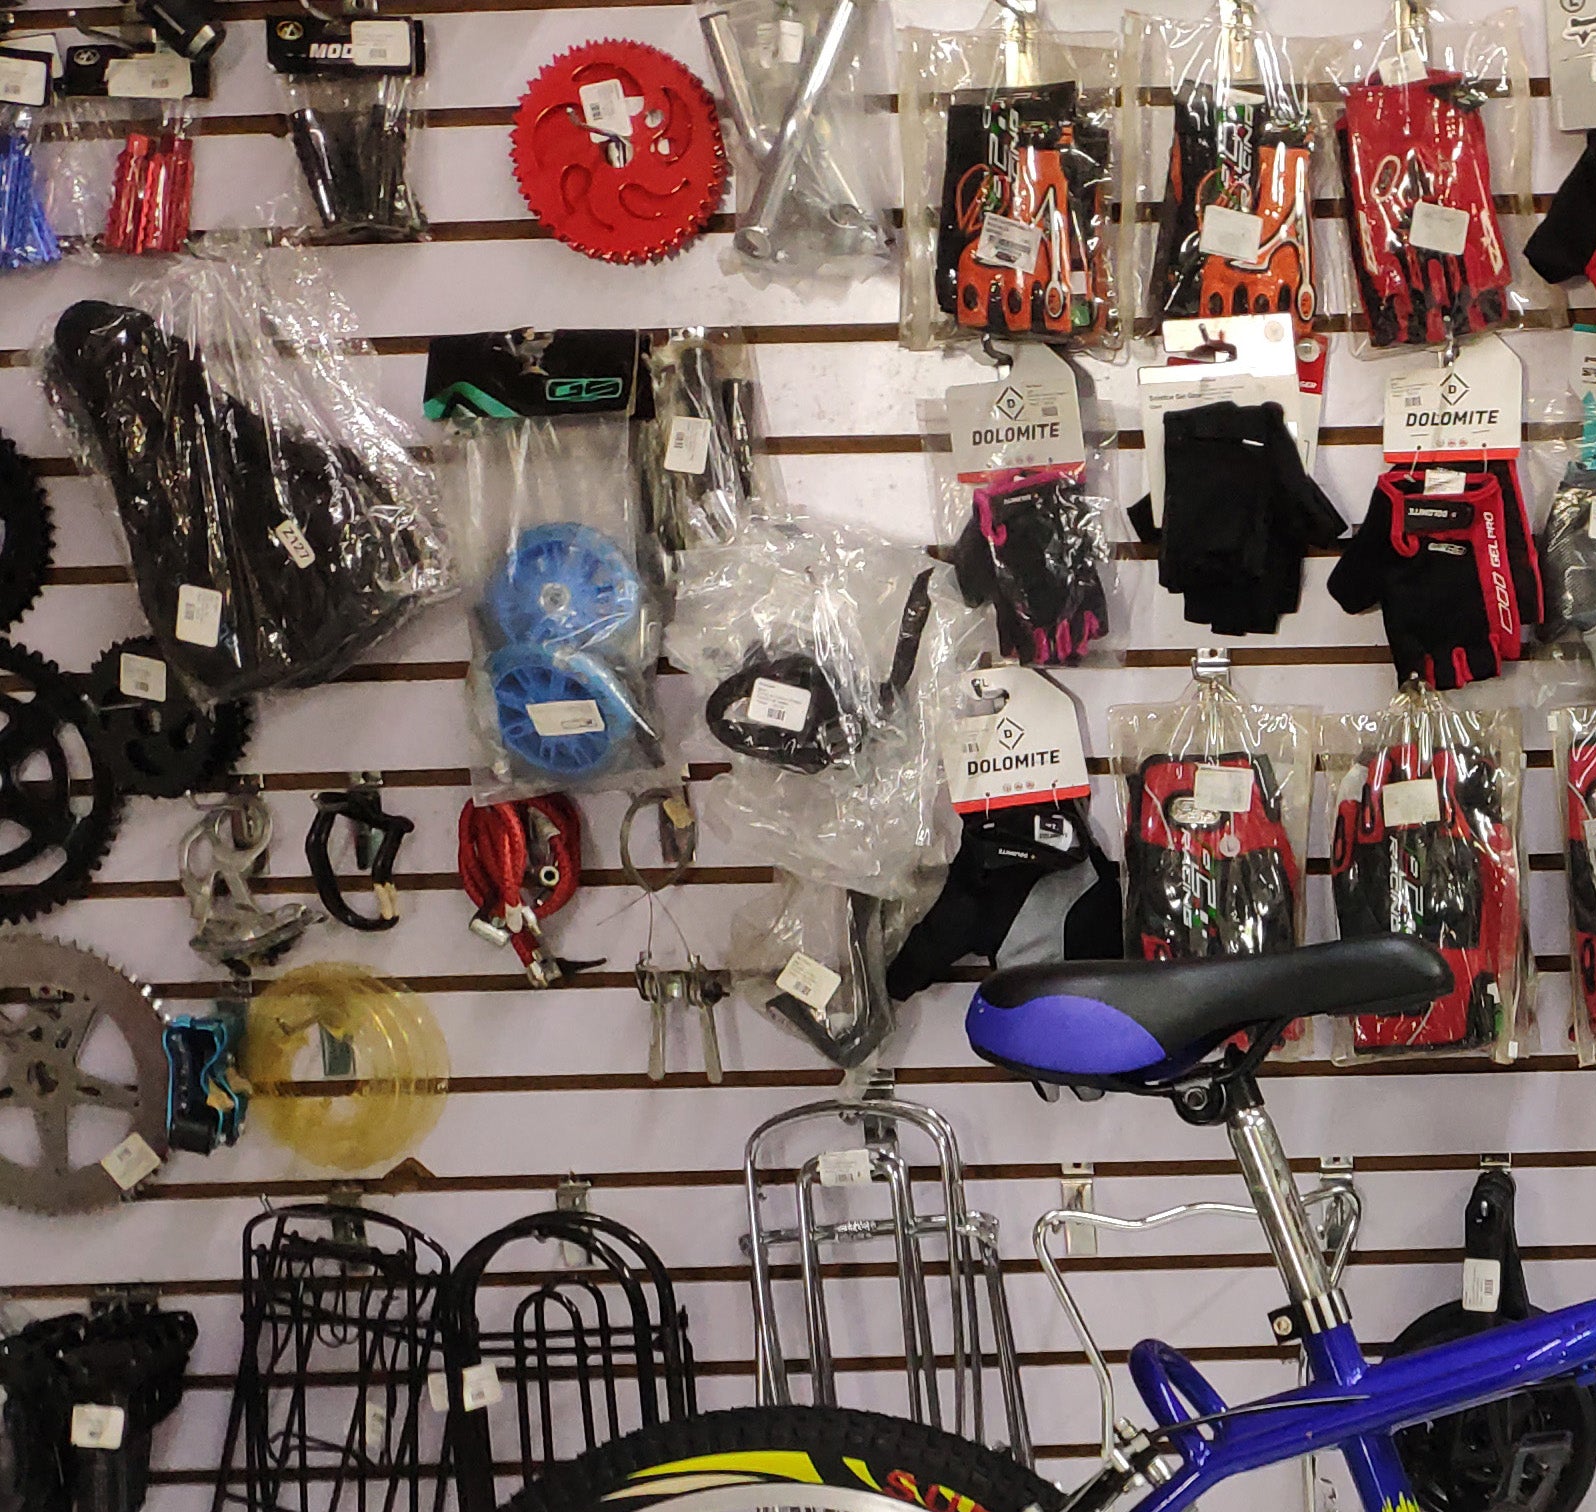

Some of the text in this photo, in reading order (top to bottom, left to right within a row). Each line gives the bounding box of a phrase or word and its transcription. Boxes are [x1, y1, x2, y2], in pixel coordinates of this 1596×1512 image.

[972, 422, 1061, 446] DOLOMITE
[1406, 410, 1499, 427] DOLOMITE
[1484, 511, 1501, 569] GEL PRO
[968, 750, 1061, 776] DOLOMITE
[1182, 828, 1193, 928] RACING
[1388, 836, 1399, 932] RACING
